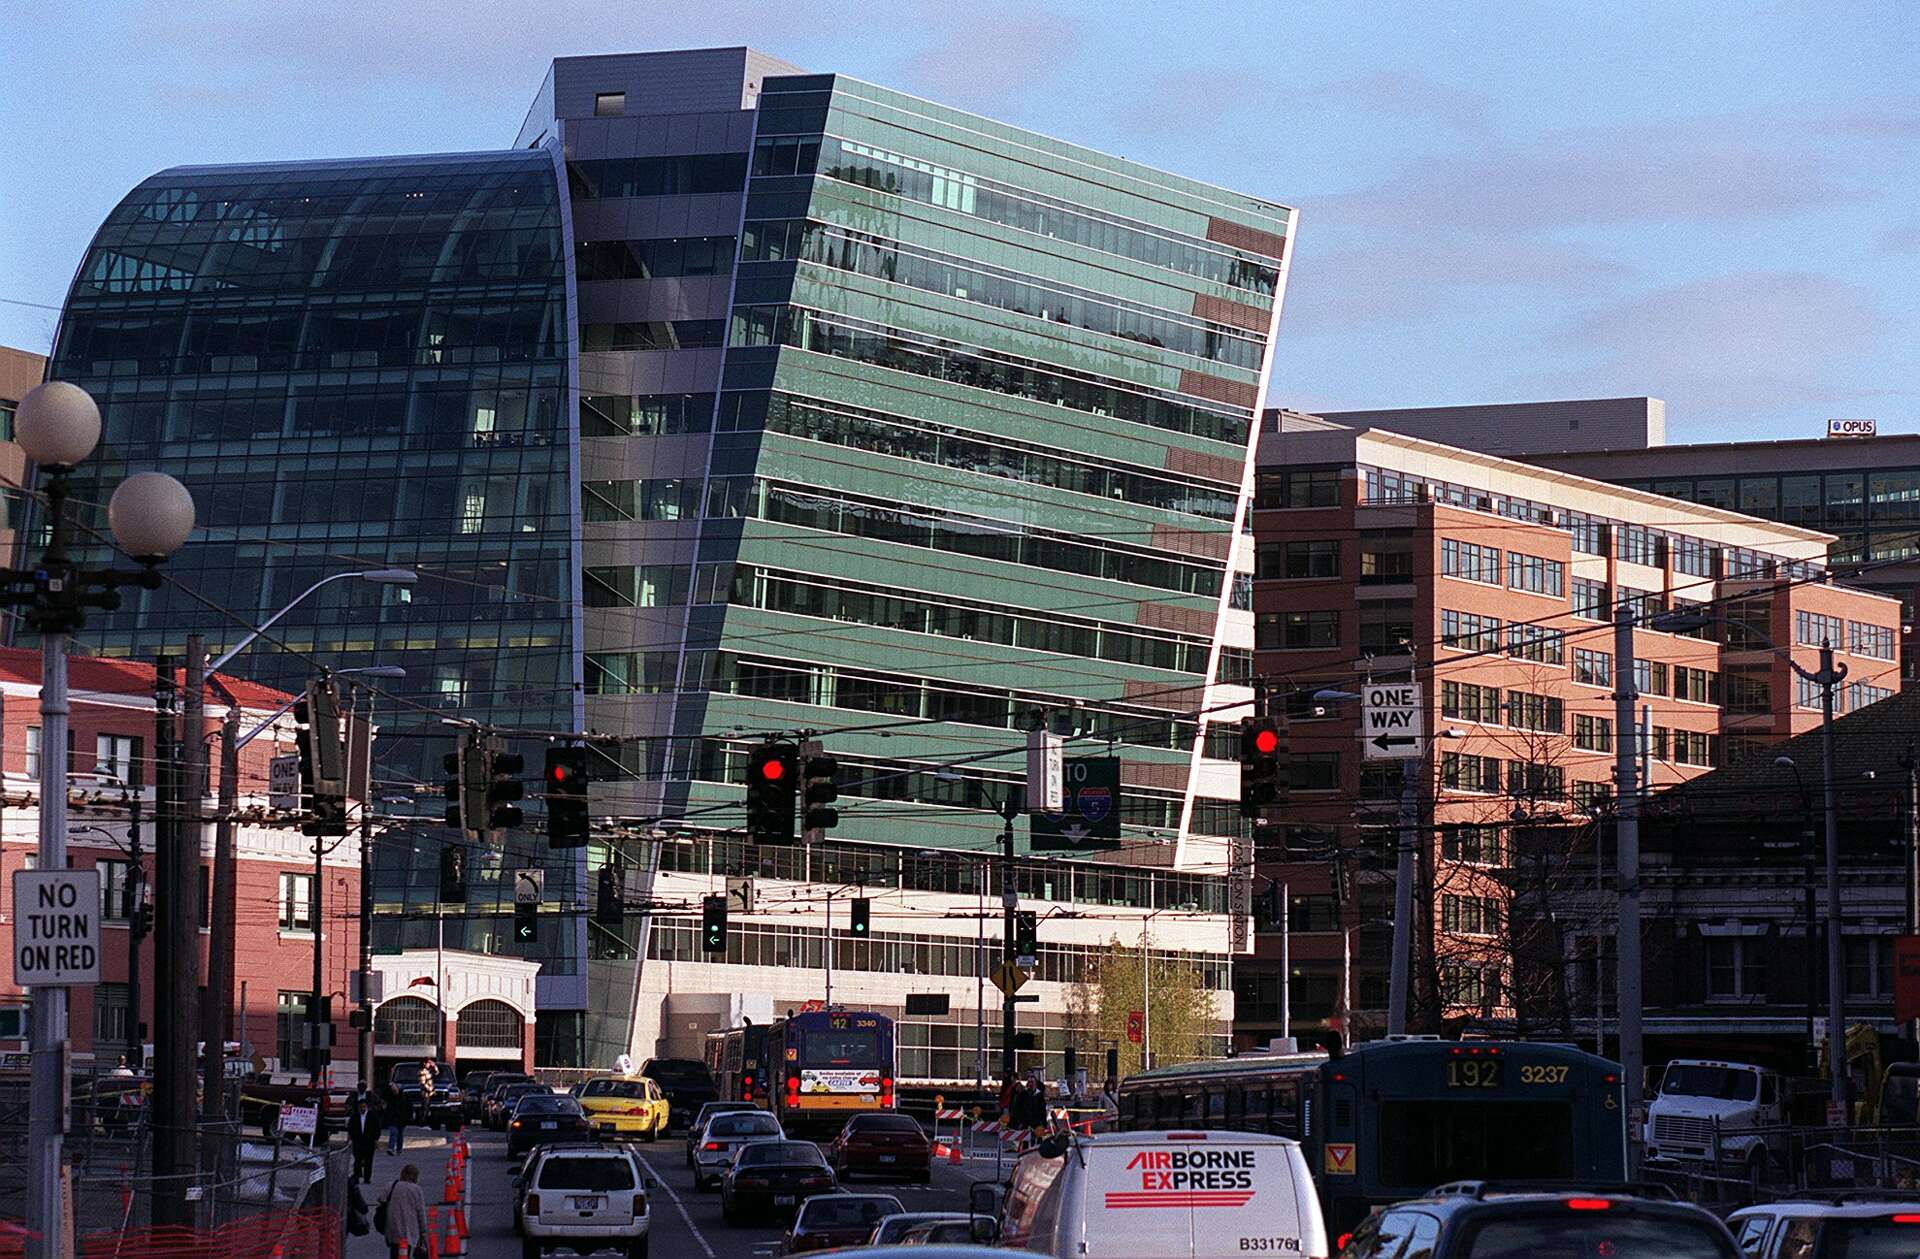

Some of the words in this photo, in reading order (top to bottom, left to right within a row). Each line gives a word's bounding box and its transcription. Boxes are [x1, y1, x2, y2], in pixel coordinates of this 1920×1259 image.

[1843, 421, 1873, 432] OPUS
[1370, 690, 1414, 707] ONE
[1370, 711, 1414, 729] WAY
[273, 762, 295, 778] ONE
[1064, 762, 1088, 782] TO
[38, 883, 77, 908] NO
[518, 893, 537, 901] ONLY
[28, 914, 88, 939] TURN
[1233, 903, 1245, 945] STATION
[21, 945, 49, 971] ON
[56, 945, 96, 970] RED
[831, 1019, 848, 1030] 42
[1447, 1060, 1497, 1087] 192
[1520, 1065, 1569, 1084] 3237
[1126, 1150, 1255, 1170] AIRBORNE
[1142, 1171, 1252, 1190] EXPRESS
